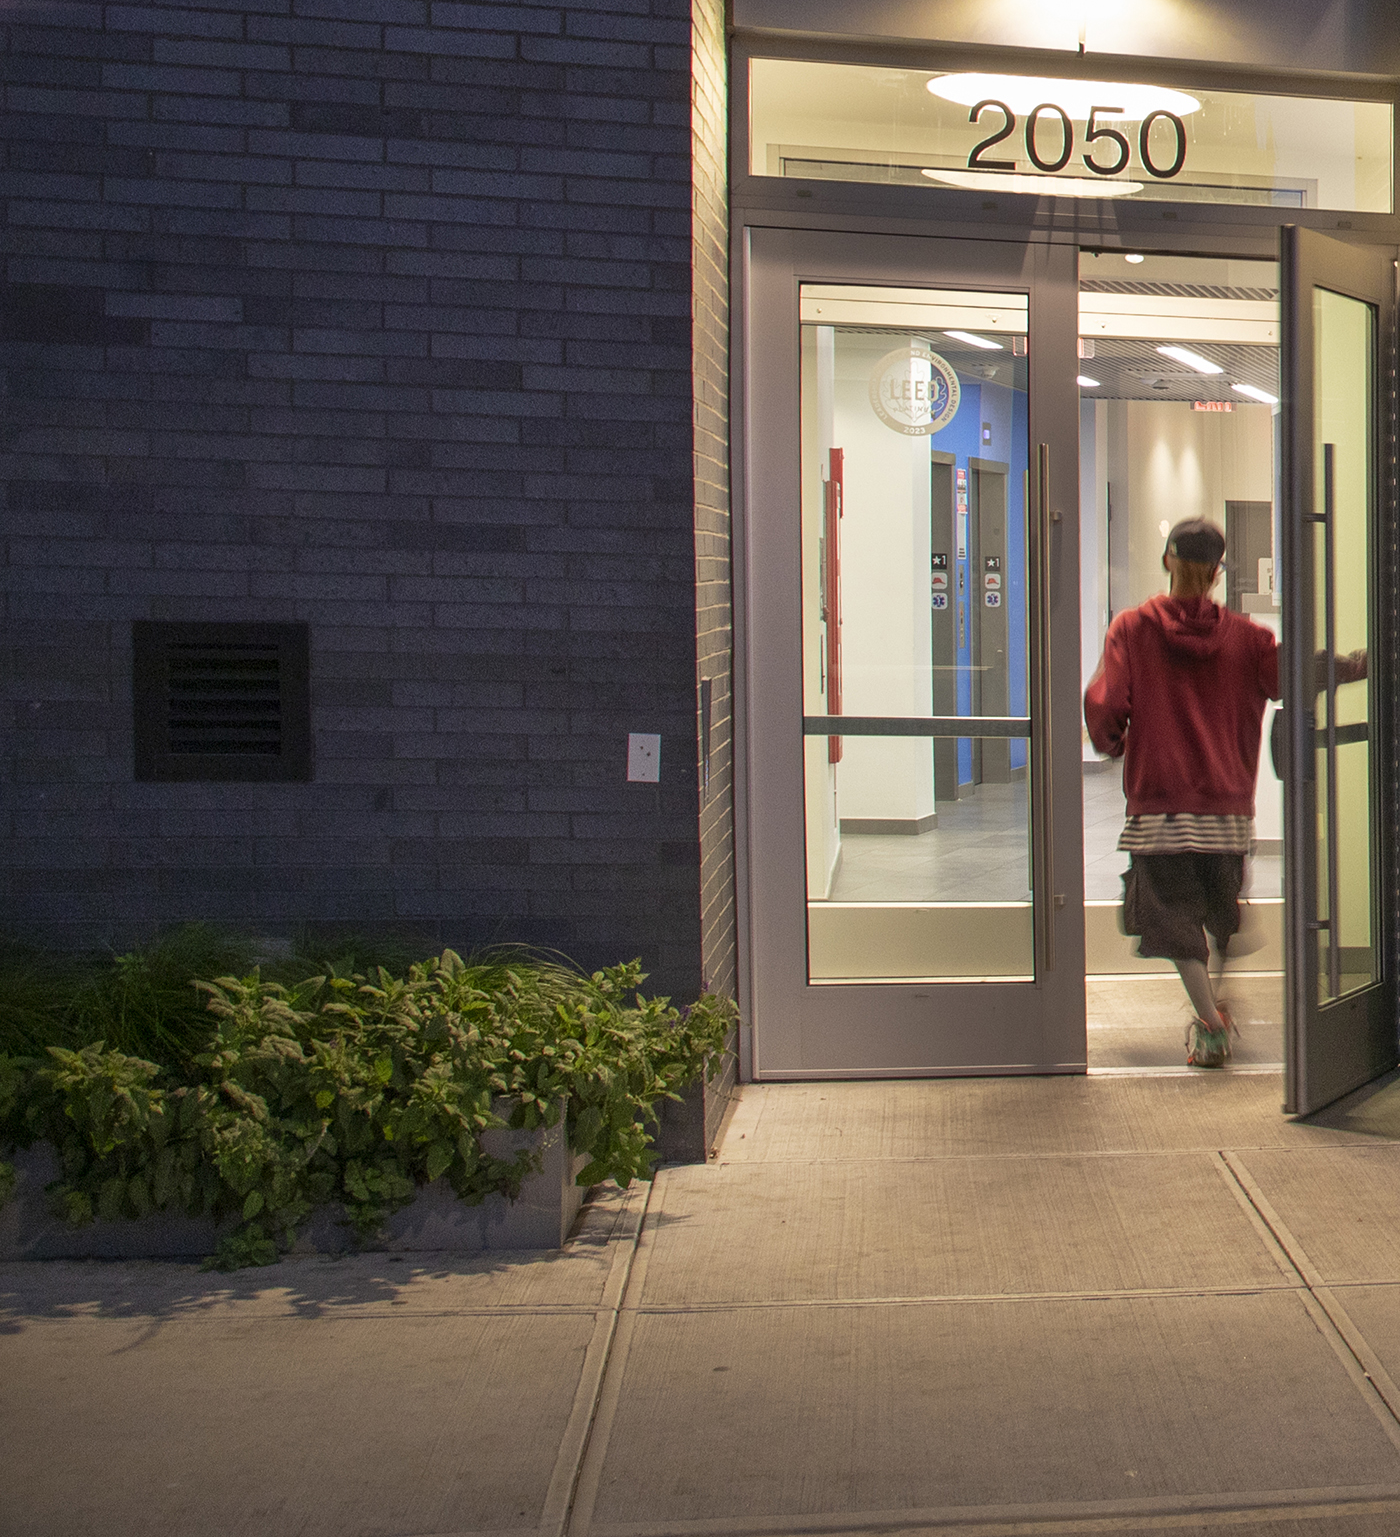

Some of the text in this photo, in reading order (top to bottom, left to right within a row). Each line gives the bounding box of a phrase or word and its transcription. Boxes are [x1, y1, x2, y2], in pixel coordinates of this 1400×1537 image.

[967, 99, 1187, 178] 2050
[889, 379, 939, 401] LEED
[941, 399, 957, 422] DESIGN
[903, 426, 926, 435] 2023
